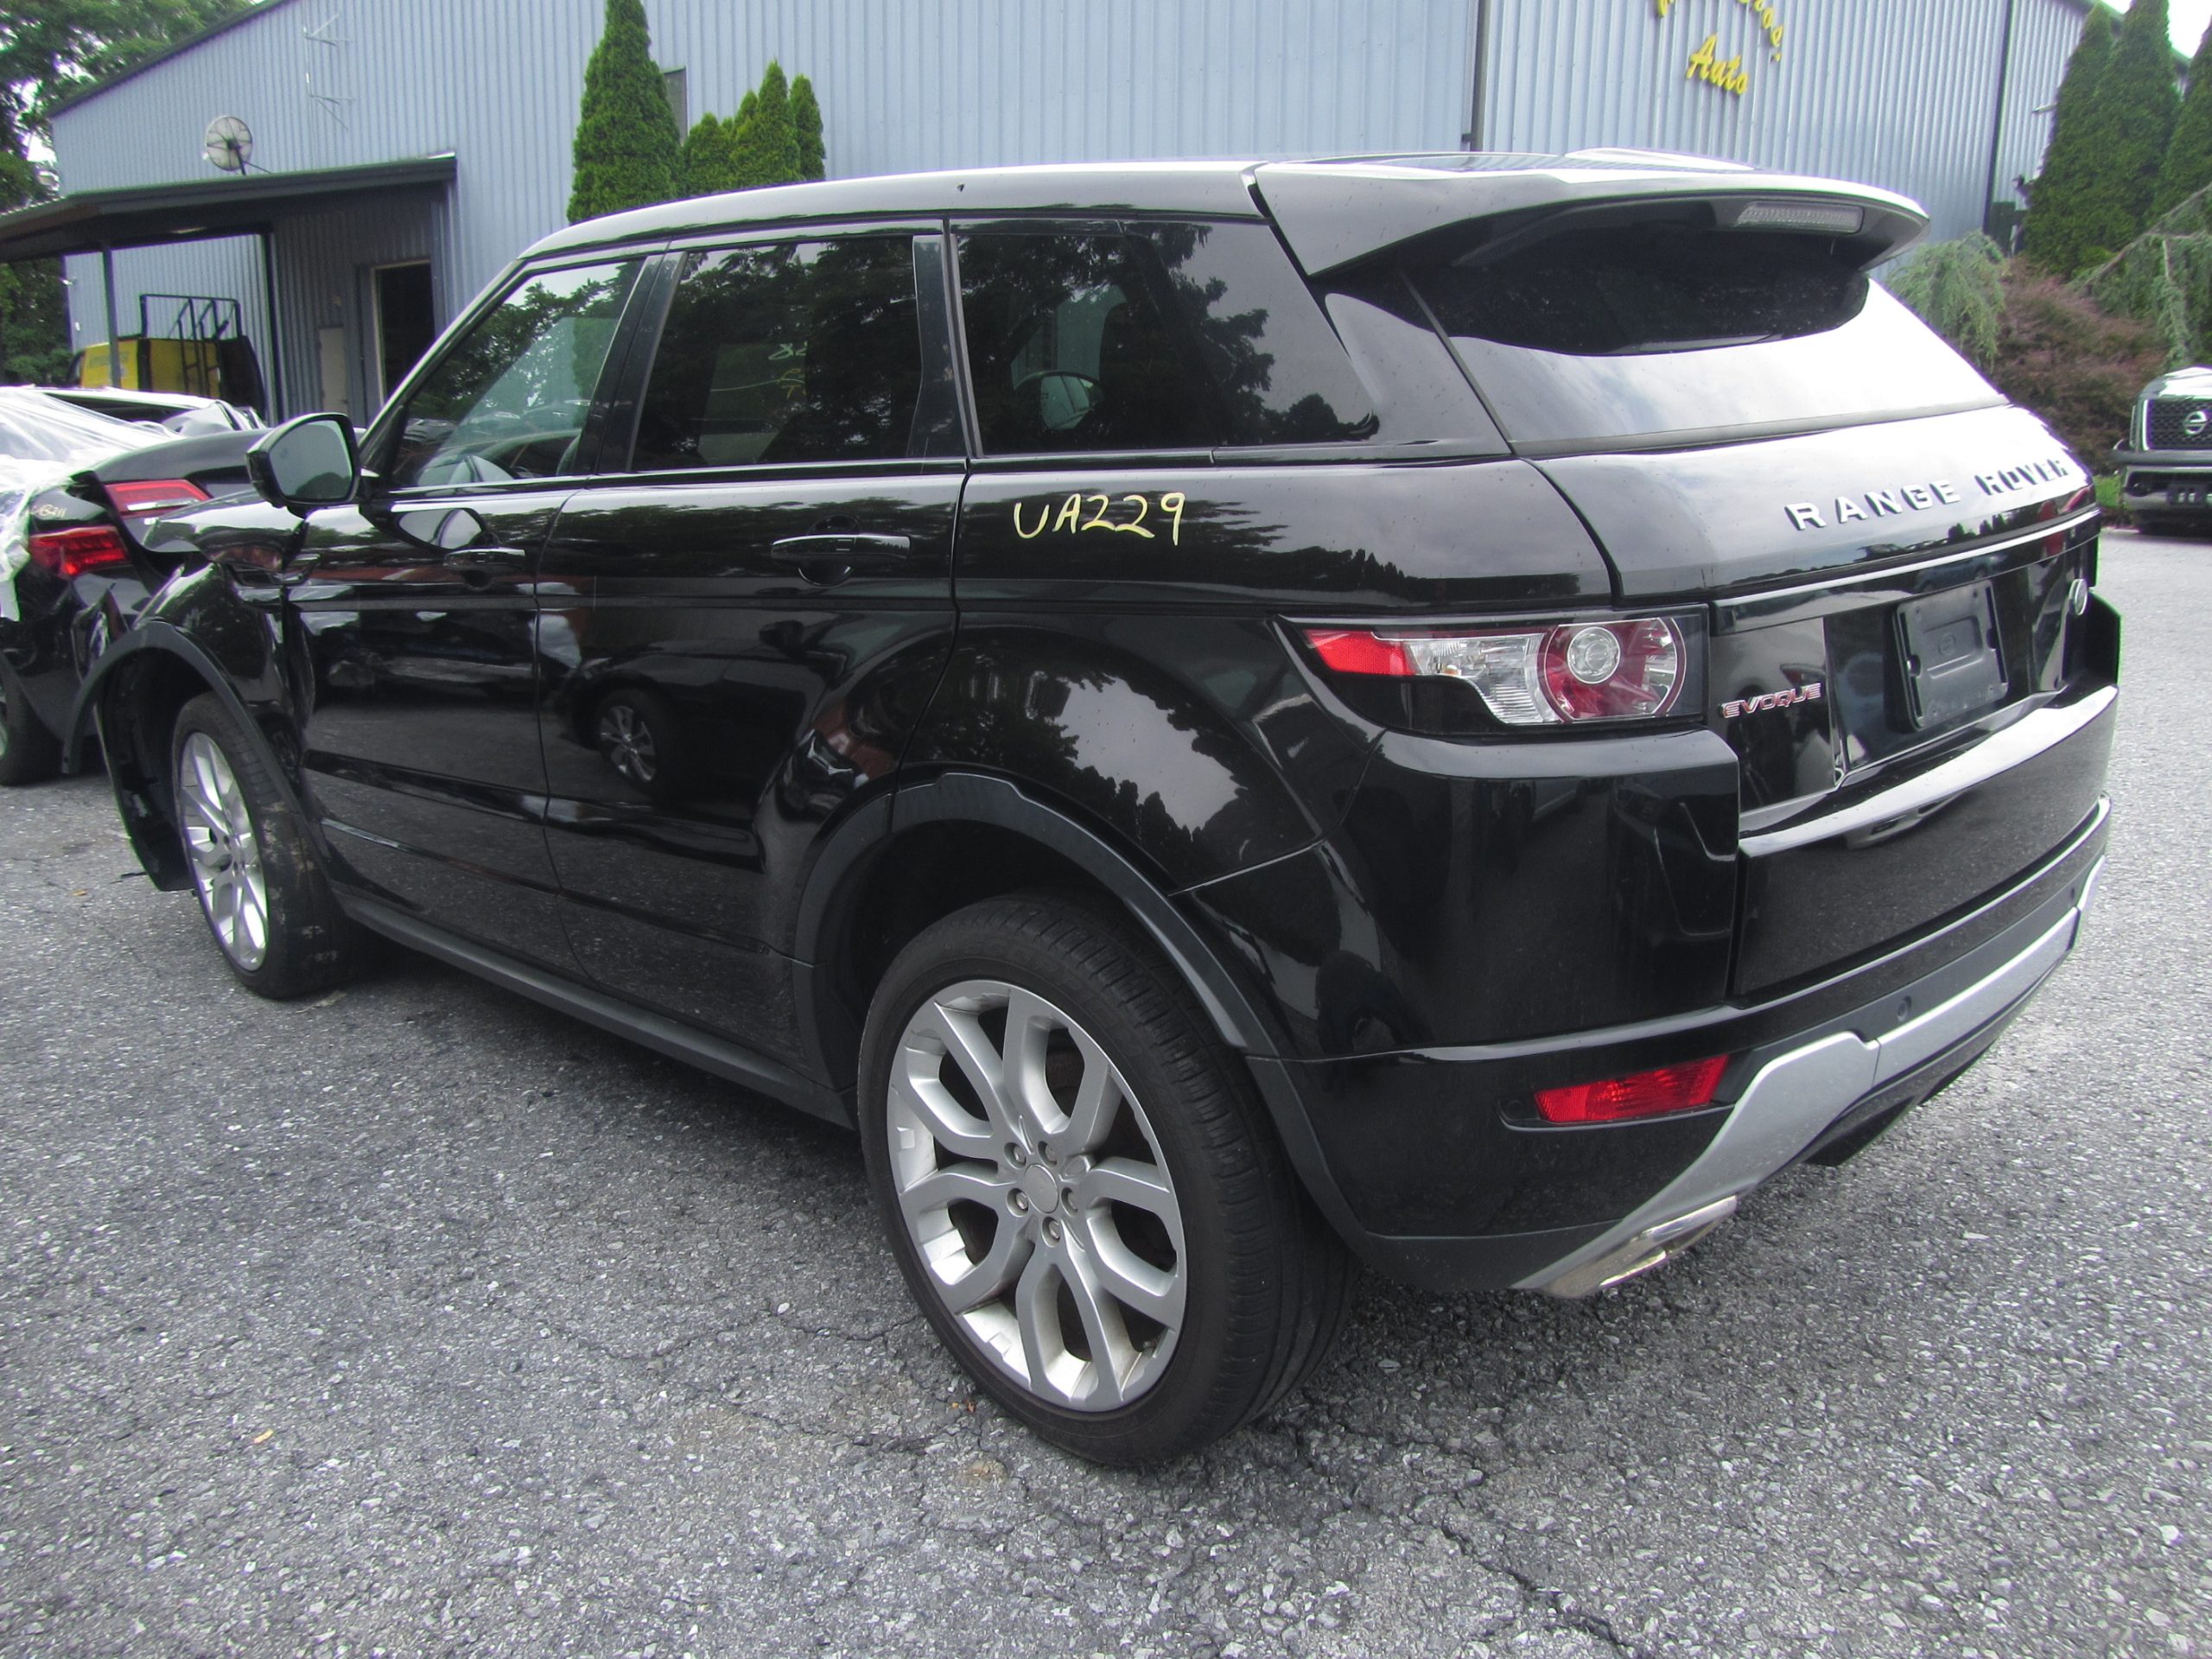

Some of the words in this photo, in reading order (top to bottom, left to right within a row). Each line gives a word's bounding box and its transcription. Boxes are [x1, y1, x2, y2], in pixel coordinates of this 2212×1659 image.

[1687, 35, 1748, 94] Auto
[1014, 492, 1186, 546] UA229
[1785, 480, 1962, 531] RANGE
[1974, 459, 2069, 496] ROVER
[1720, 683, 1821, 719] EVOQUE
